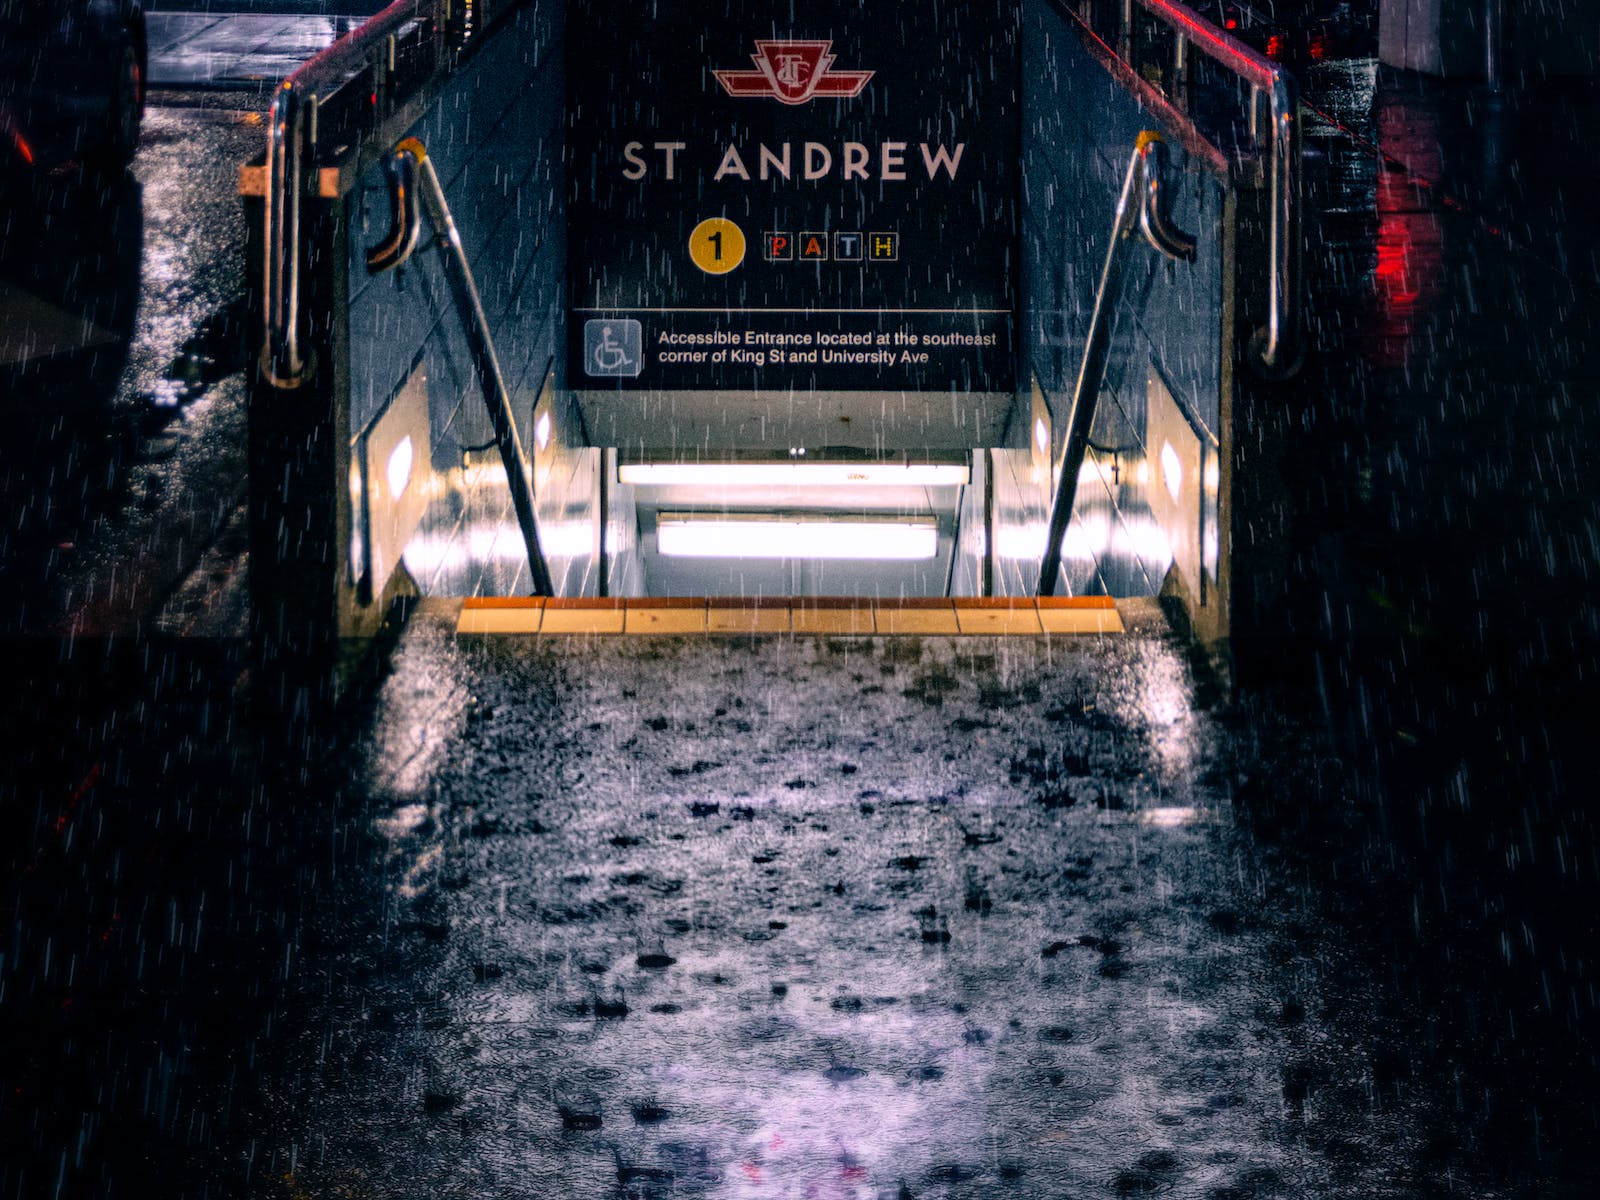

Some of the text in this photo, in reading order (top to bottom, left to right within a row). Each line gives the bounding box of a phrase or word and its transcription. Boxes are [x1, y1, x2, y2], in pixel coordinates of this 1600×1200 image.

[623, 141, 965, 182] ST ANDREW
[659, 331, 997, 346] Accessible Entrance located at the southeast
[659, 349, 929, 367] corner of King St and University Ave
